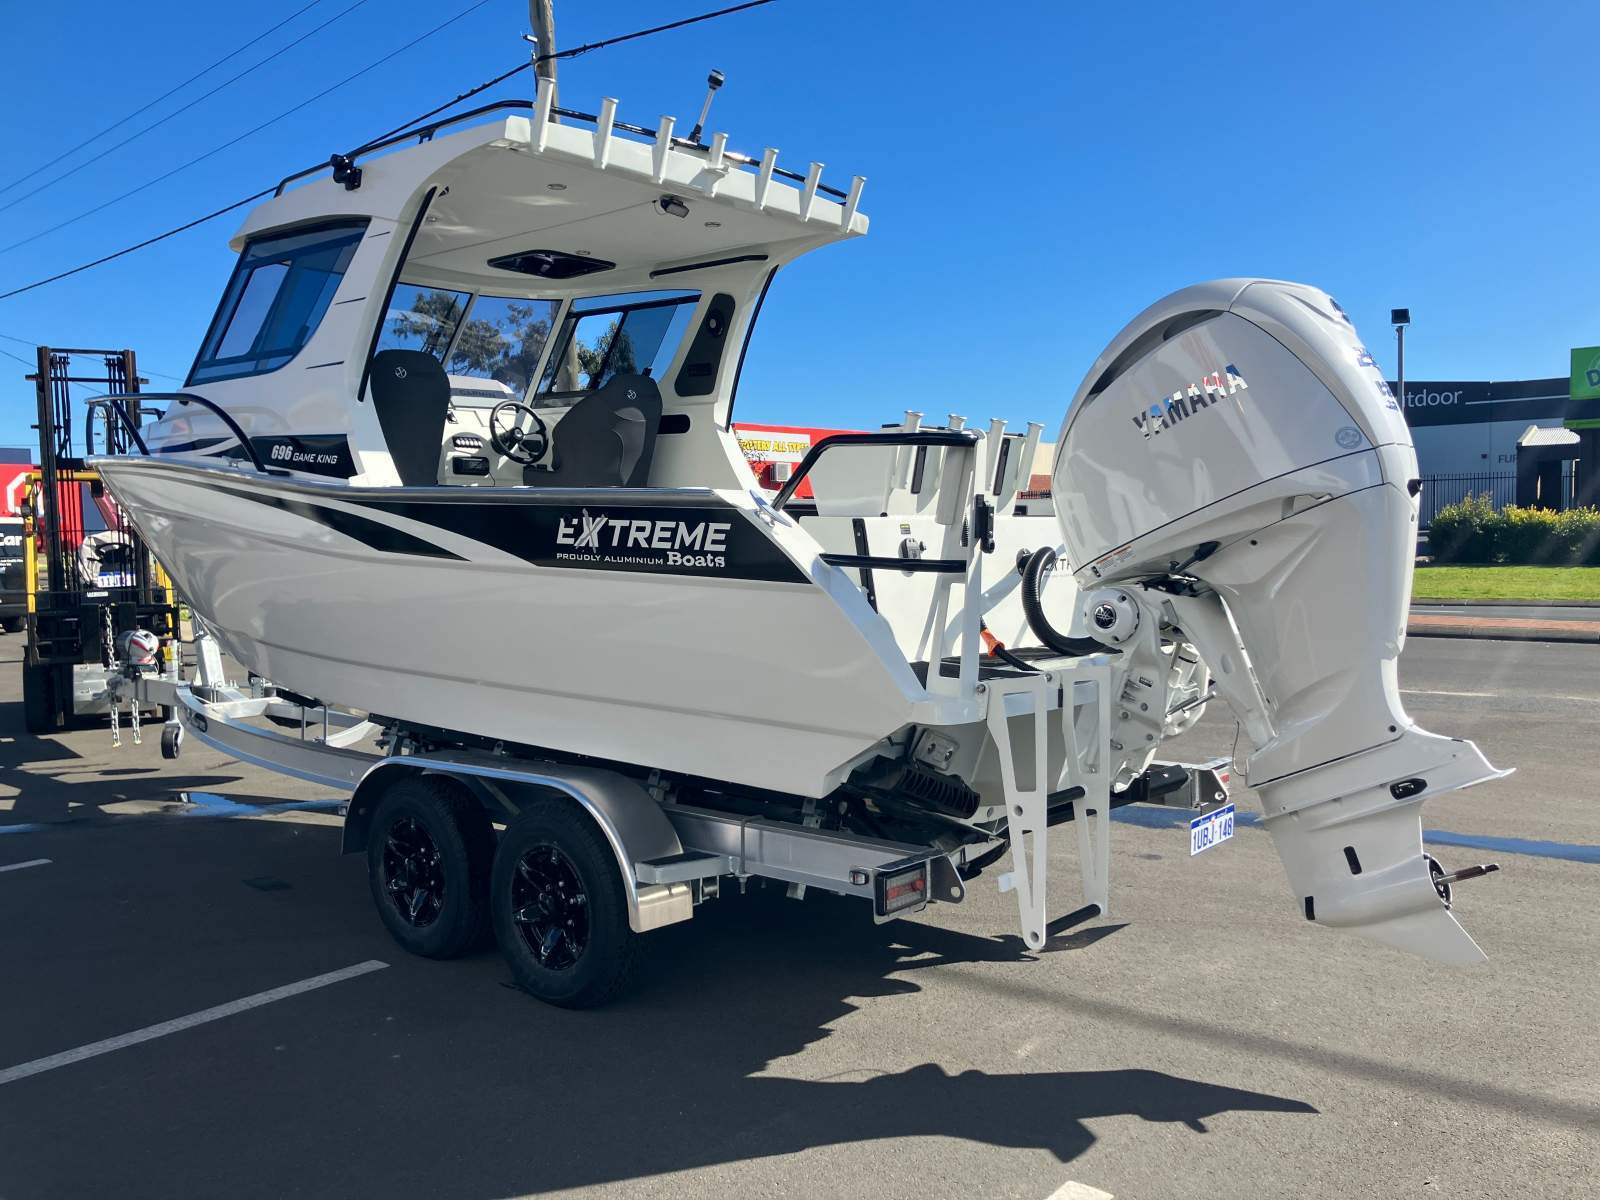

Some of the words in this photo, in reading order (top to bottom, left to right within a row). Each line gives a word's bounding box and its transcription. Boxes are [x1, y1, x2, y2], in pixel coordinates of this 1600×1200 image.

[1132, 363, 1248, 440] YAMAHA
[1402, 389, 1463, 408] tdoor
[271, 444, 293, 460] 696
[293, 453, 316, 463] GAME
[317, 454, 338, 465] KING
[556, 508, 731, 553] EXTREME
[556, 552, 601, 562] PROUDLY
[604, 555, 663, 565] ALUMINIUM
[667, 551, 725, 568] Boats
